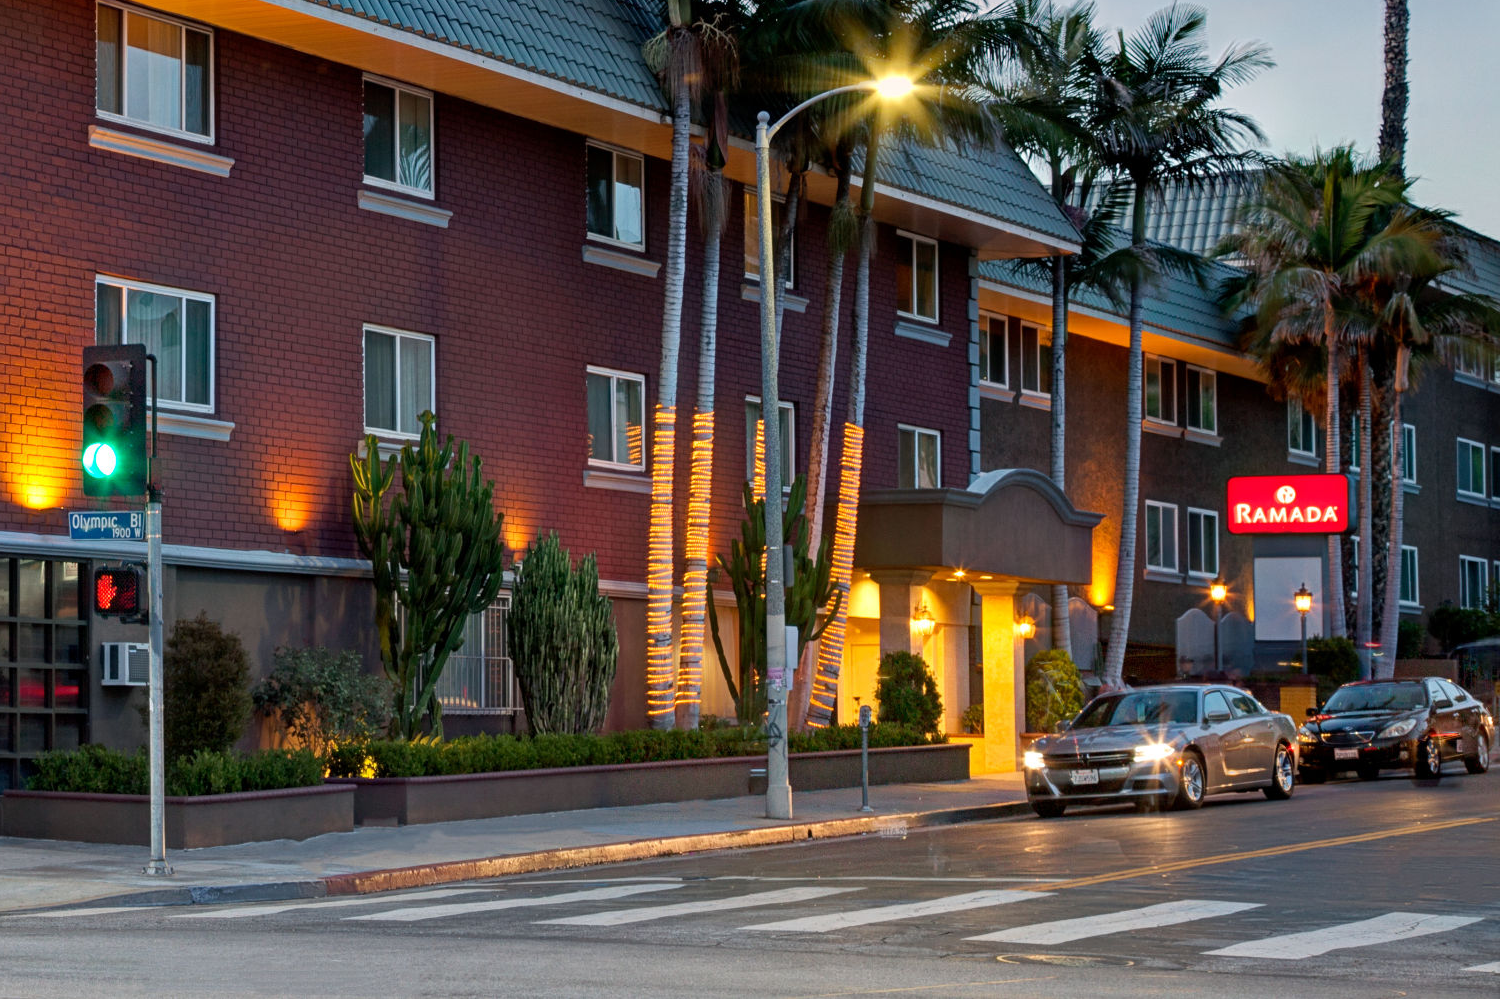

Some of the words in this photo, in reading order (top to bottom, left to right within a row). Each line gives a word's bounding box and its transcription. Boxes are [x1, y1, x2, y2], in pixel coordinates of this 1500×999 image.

[72, 514, 118, 532] Olympic
[130, 513, 142, 528] Bl
[1235, 503, 1338, 523] RAMADA
[112, 528, 131, 538] 1900
[134, 528, 141, 538] W
